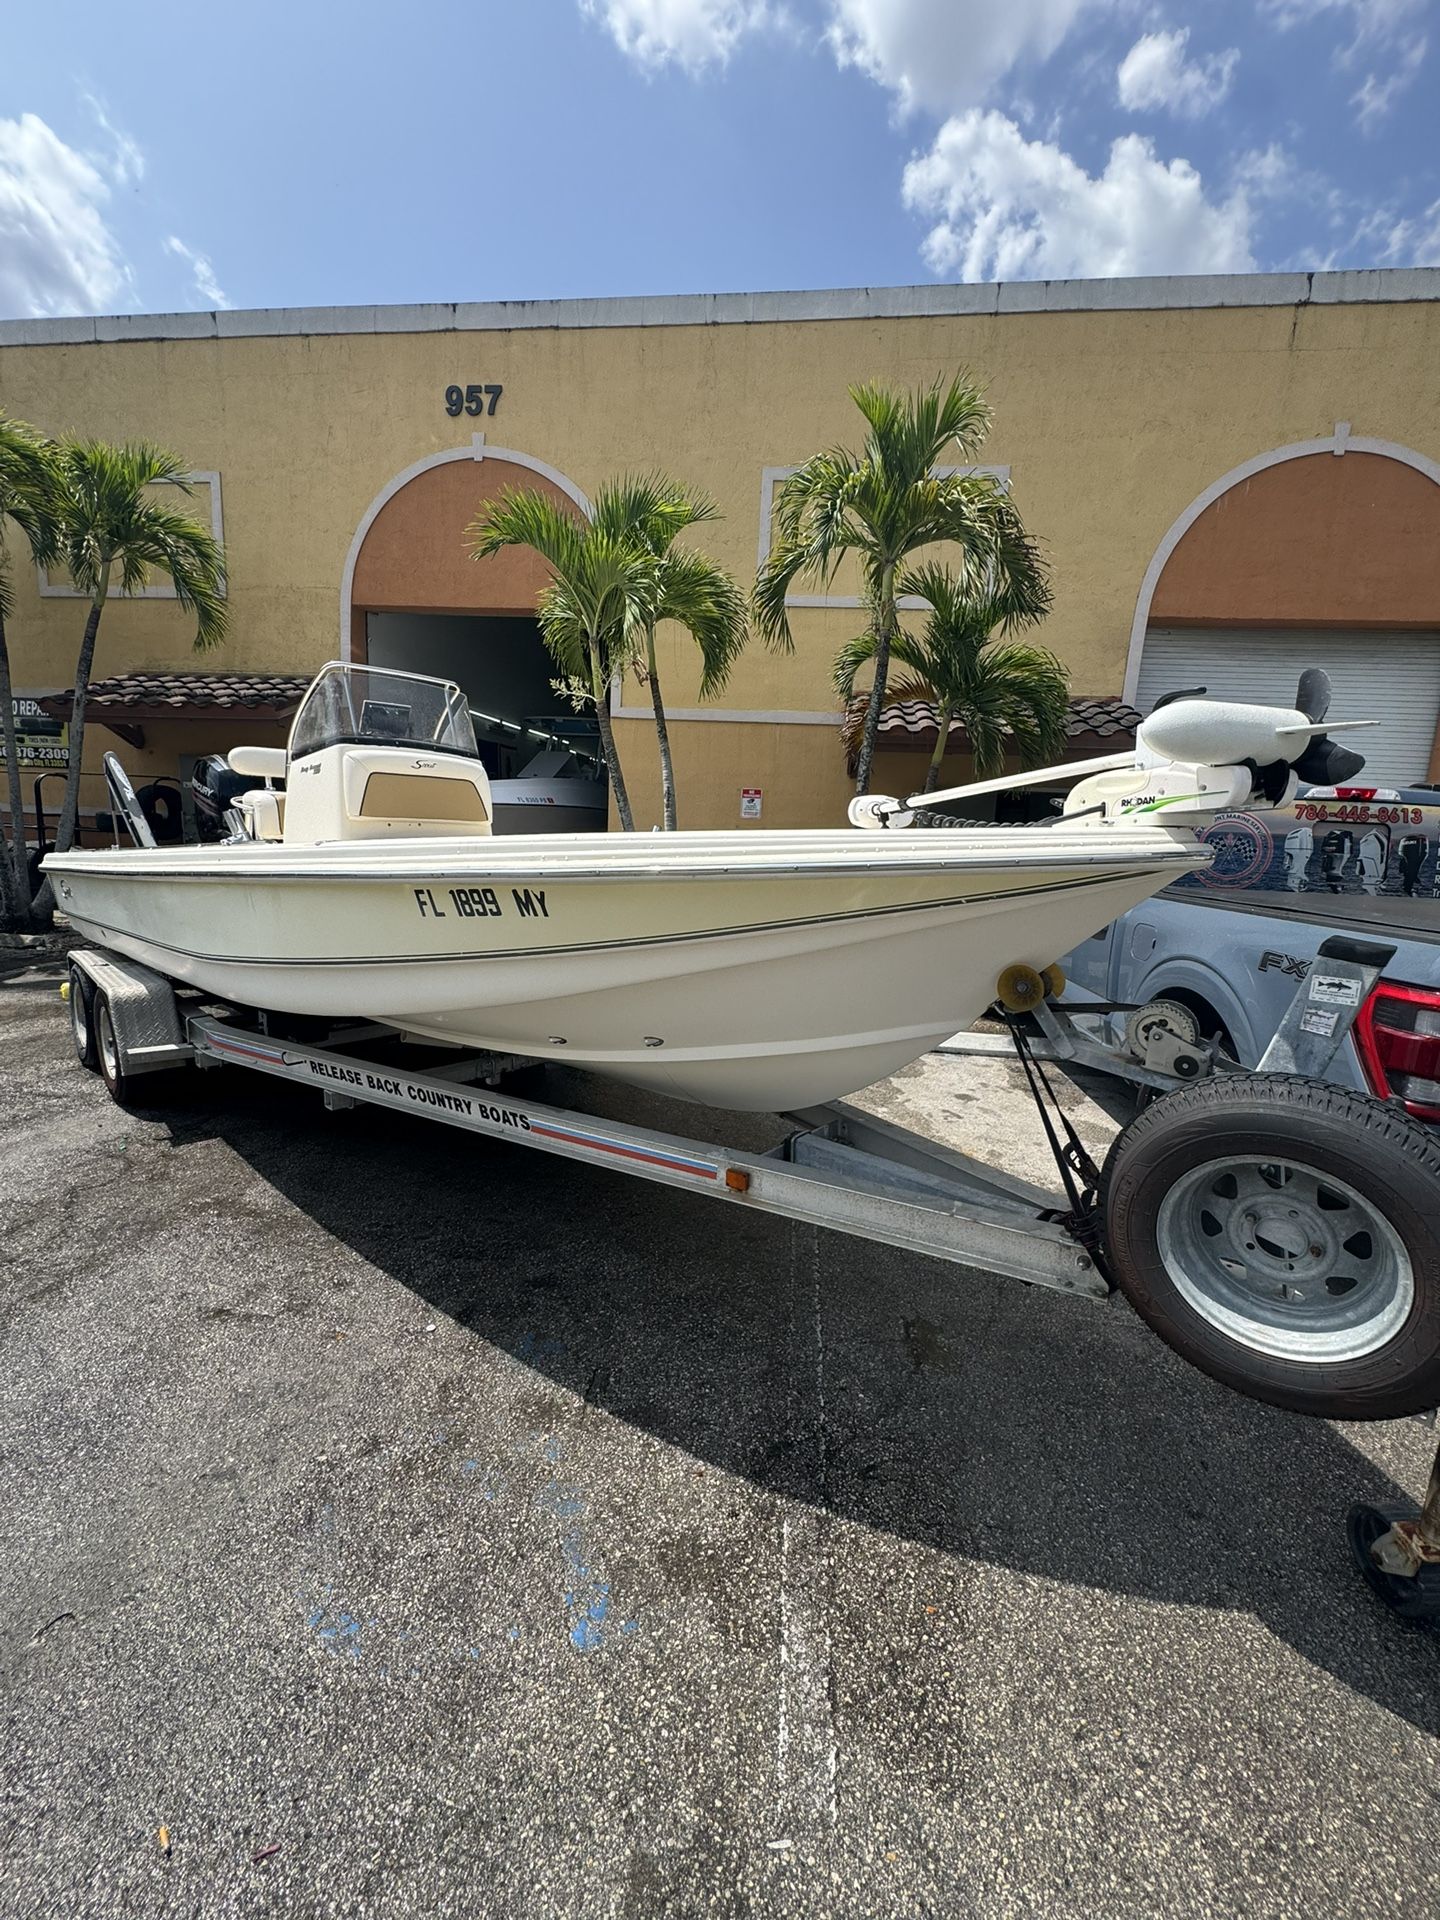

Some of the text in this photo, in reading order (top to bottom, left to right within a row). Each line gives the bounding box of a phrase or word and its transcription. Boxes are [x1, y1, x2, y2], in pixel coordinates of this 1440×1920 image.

[445, 384, 503, 417] 957
[20, 700, 49, 716] REPA
[1295, 804, 1424, 824] 786-445-8613
[414, 888, 549, 917] FL 1899 MY
[1258, 950, 1312, 979] FX
[309, 1060, 531, 1131] RELEASE BACK COUNTRY BOATS
